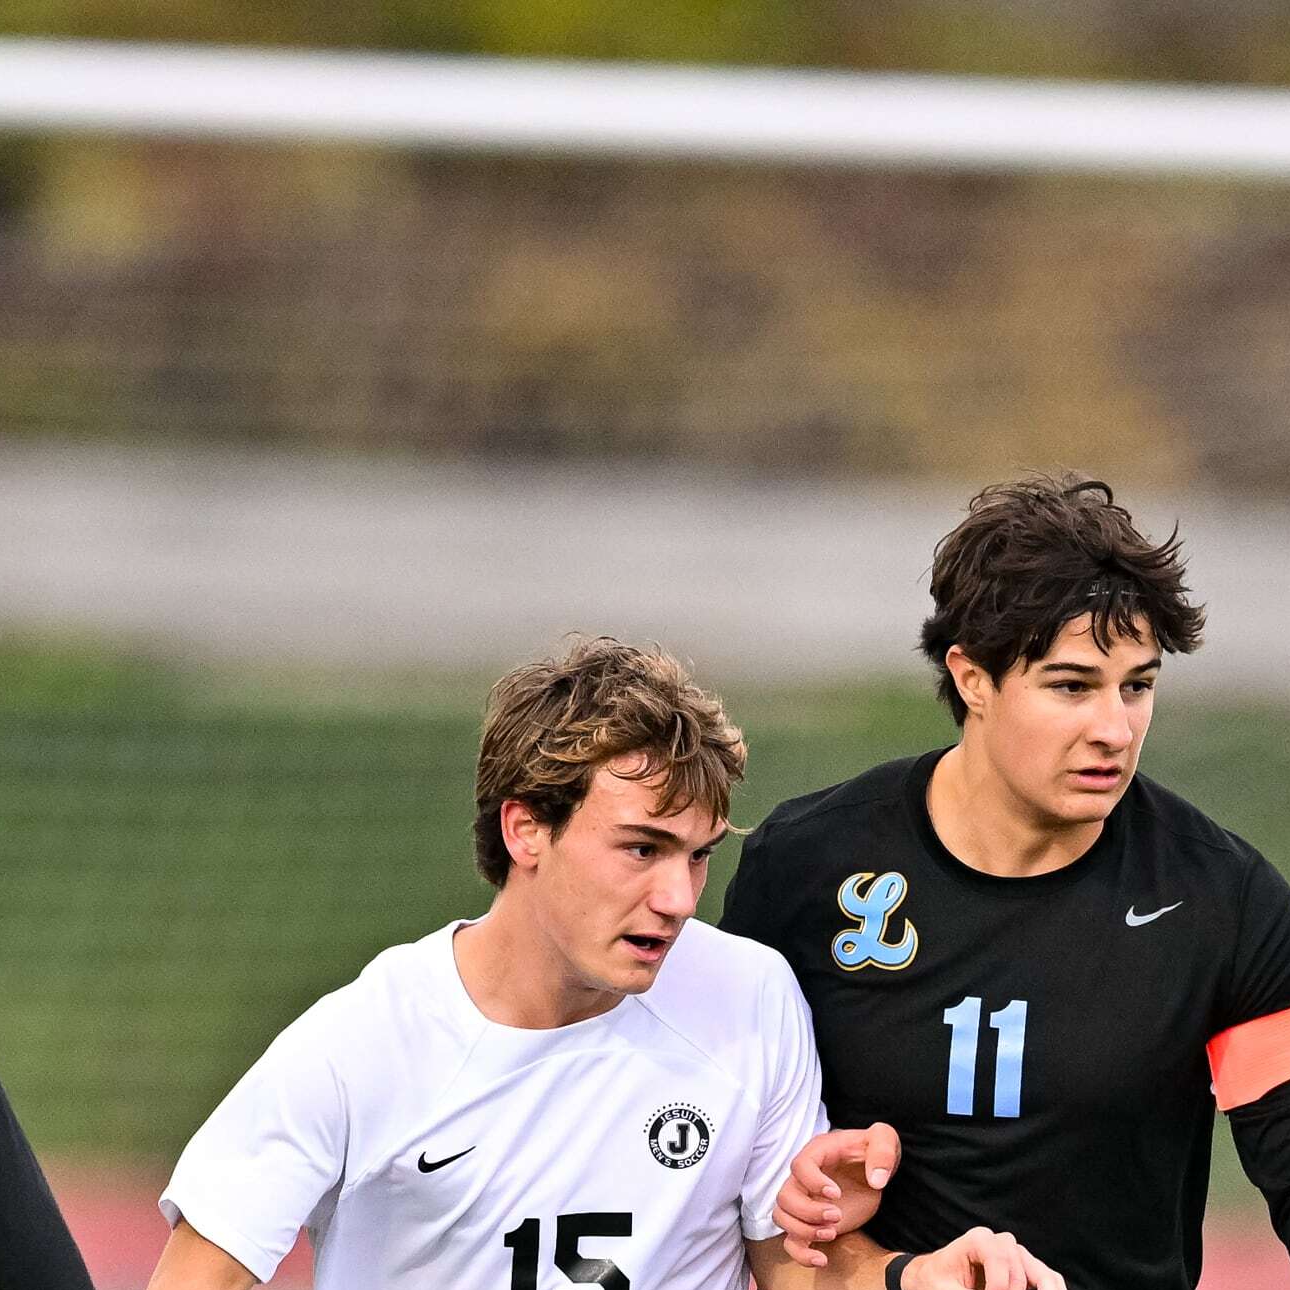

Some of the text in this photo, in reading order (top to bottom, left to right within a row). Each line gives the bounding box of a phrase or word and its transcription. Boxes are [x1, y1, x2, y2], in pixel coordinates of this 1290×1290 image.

[943, 996, 1028, 1118] 11
[660, 1109, 700, 1125] JESUIT
[667, 1123, 690, 1155] J
[677, 1138, 709, 1168] SOCCER
